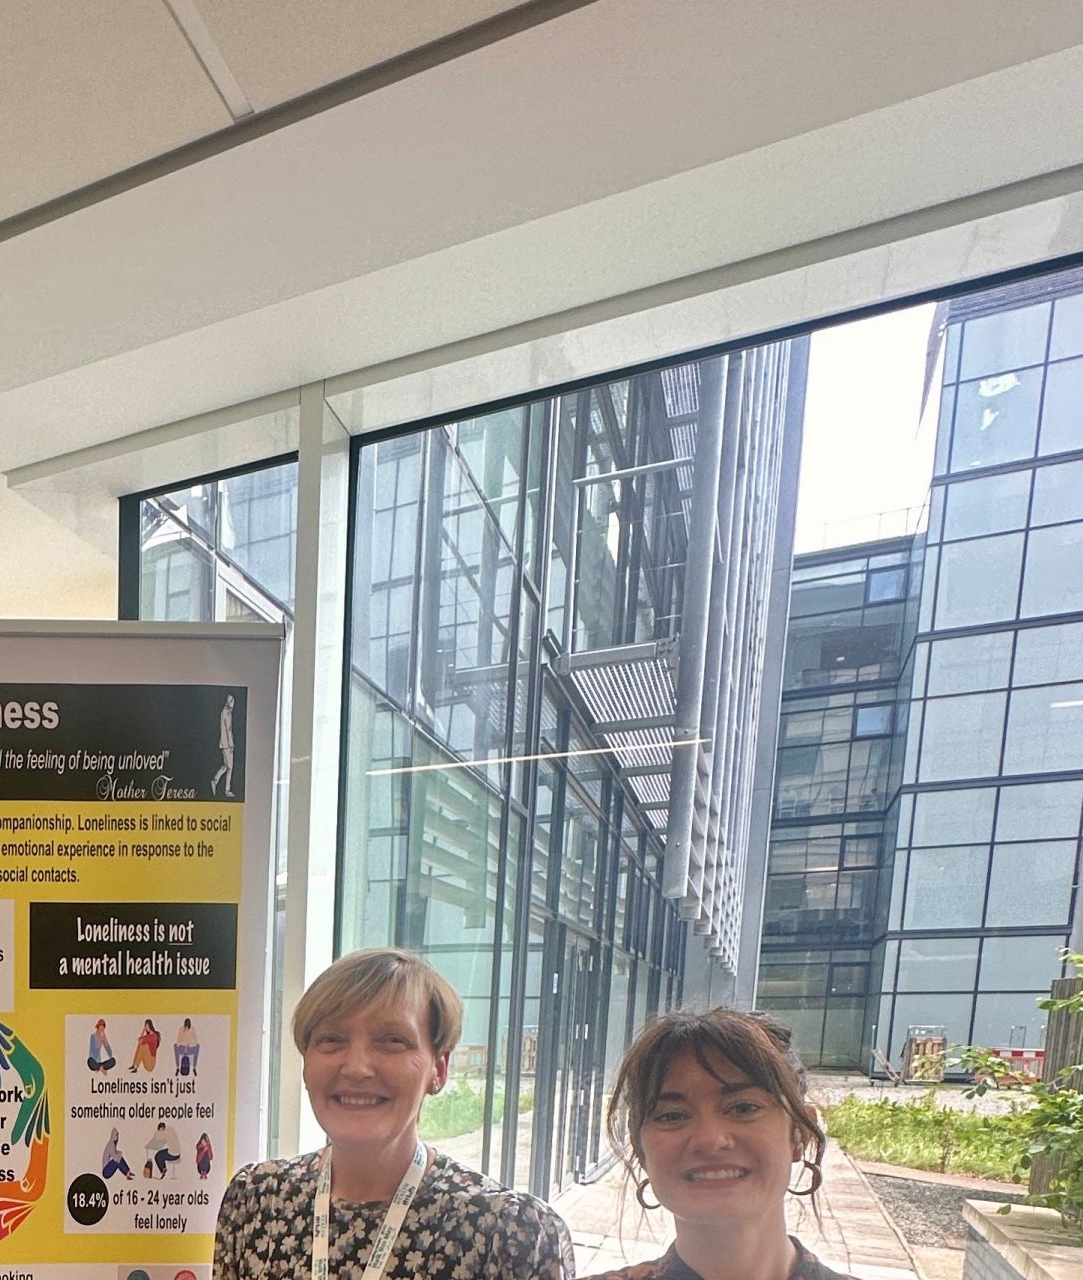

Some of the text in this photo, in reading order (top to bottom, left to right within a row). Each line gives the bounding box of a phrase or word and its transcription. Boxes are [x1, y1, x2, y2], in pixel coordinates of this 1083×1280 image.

[5, 749, 24, 769] the
[26, 748, 66, 775] feeling
[68, 749, 82, 770] of
[82, 750, 116, 776] being
[96, 775, 197, 801] Mother Teresa
[76, 916, 194, 946] Loneliness is not
[59, 950, 210, 976] a mental health issue
[90, 1078, 148, 1094] Loneliness
[174, 1078, 196, 1098] just
[70, 1102, 214, 1120] something older people feel
[72, 1192, 107, 1208] 18.4%
[112, 1189, 124, 1206] of
[126, 1189, 139, 1206] 16
[147, 1189, 160, 1205] 24
[162, 1193, 186, 1210] year
[187, 1189, 209, 1206] olds
[134, 1213, 188, 1234] feel lonely
